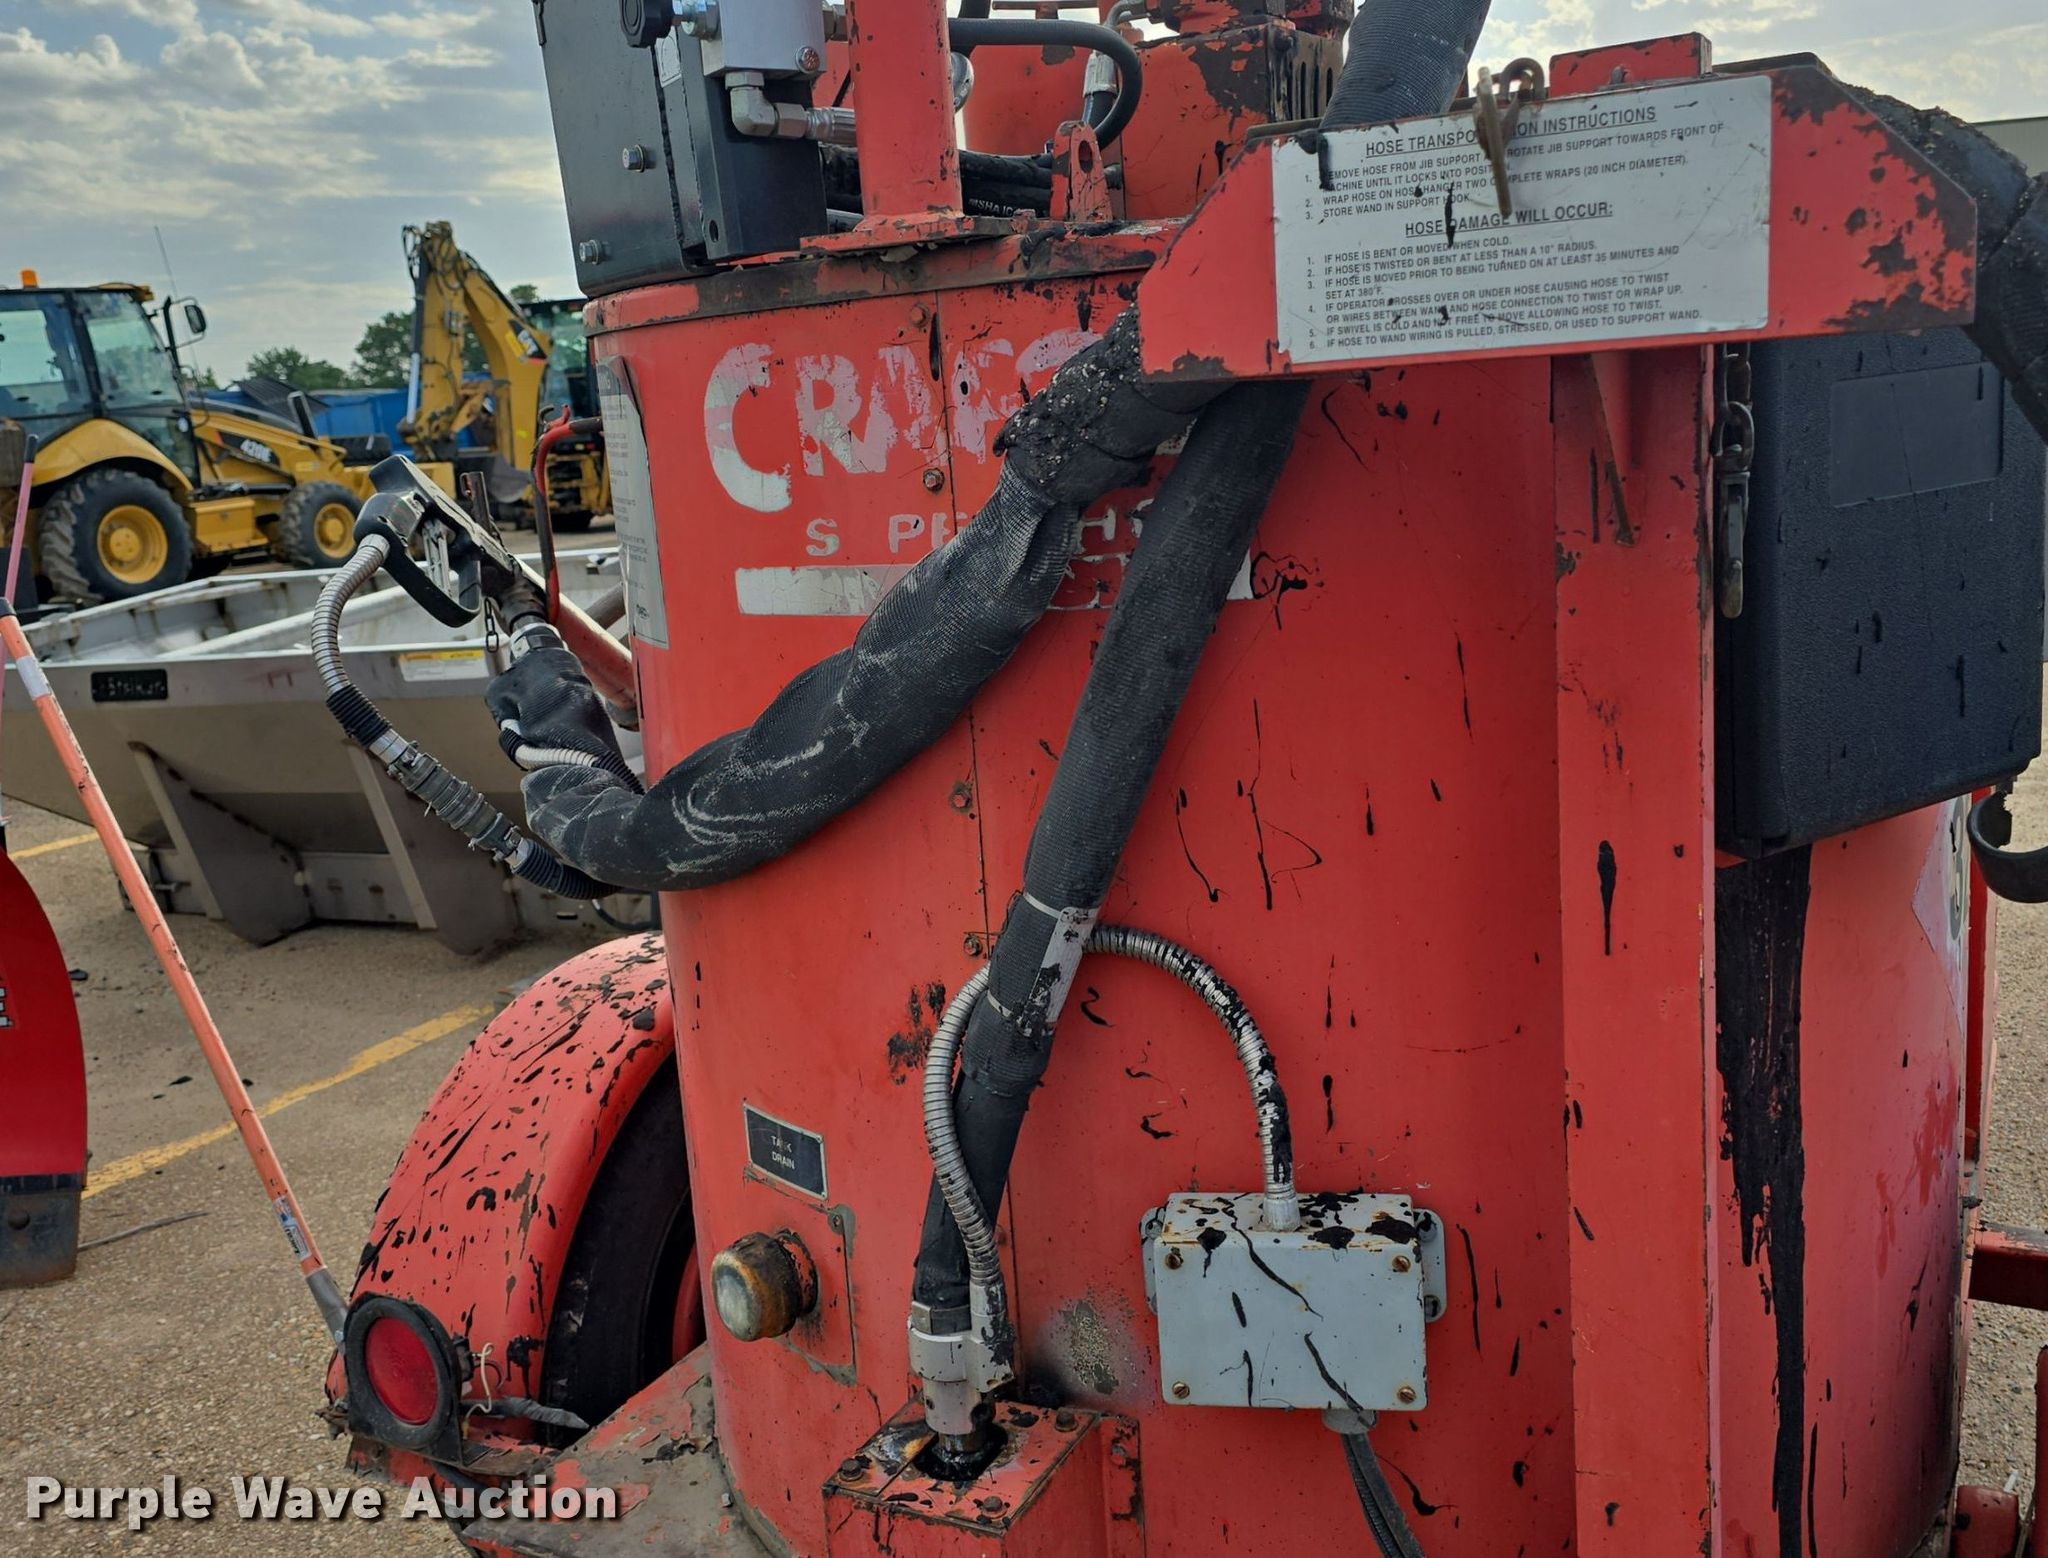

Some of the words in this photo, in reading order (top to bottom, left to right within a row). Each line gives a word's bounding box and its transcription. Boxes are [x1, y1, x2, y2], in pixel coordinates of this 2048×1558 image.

[1366, 138, 1403, 155] HOSE
[1410, 121, 1537, 150] TRANSPOION
[1543, 107, 1656, 134] INSTRUCTIONS
[1323, 168, 1360, 180] EMOVE
[1362, 165, 1387, 176] HOSE
[1390, 161, 1416, 172] FROM
[1419, 159, 1433, 169] JIB
[1436, 153, 1481, 167] SUPPORT
[1506, 145, 1544, 158] ROTATE
[1547, 143, 1562, 154] JIB
[1565, 137, 1612, 151] SUPPORT
[1616, 131, 1667, 145] TOWARDS
[1670, 126, 1706, 139] FRONT
[1709, 124, 1724, 134] OF
[1323, 180, 1363, 193] ACHINE
[1366, 177, 1392, 188] UNTIL
[1394, 175, 1403, 185] IT
[1405, 171, 1437, 183] LOCKS
[1440, 169, 1461, 179] INTO
[1323, 194, 1349, 205] WRAP
[1351, 190, 1376, 202] HOSE
[1379, 189, 1392, 199] ON
[1394, 185, 1421, 197] HOS
[1465, 178, 1486, 189] TWO
[1545, 167, 1580, 180] WRAPS
[1583, 165, 1598, 177] (20
[1601, 162, 1625, 174] INCH
[1323, 206, 1353, 218] STORE
[1355, 203, 1382, 214] WAND
[1385, 202, 1393, 211] IN
[1396, 196, 1440, 210] SUPPORT
[1405, 220, 1443, 235] HOSE
[1515, 208, 1549, 224] WILL
[1324, 254, 1333, 263] IF
[1335, 252, 1359, 262] HOSE
[1361, 250, 1370, 260] IS
[1373, 248, 1397, 258] BENT
[1399, 246, 1413, 256] OR
[1415, 243, 1449, 254] MOVED
[1452, 240, 1480, 251] WHEN
[1324, 266, 1333, 275] IF
[1335, 264, 1359, 274] HOSE
[1362, 262, 1371, 272] IS
[1373, 258, 1414, 271] TWISTED
[1416, 257, 1430, 267] OR
[1432, 254, 1457, 265] BENT
[1459, 253, 1471, 263] AT
[1474, 250, 1498, 261] LESS
[1501, 247, 1527, 259] THAN
[1530, 247, 1536, 256] A
[1540, 245, 1554, 255] 10"
[1325, 278, 1333, 287] IF
[1335, 276, 1360, 286] HOSE
[1362, 275, 1371, 284] IS
[1374, 271, 1406, 283] MOVED
[1408, 269, 1437, 280] PRIOR
[1440, 267, 1453, 277] TO
[1455, 264, 1485, 275] BEING
[1487, 260, 1526, 273] TURNED
[1529, 259, 1543, 269] ON
[1545, 257, 1558, 267] AT
[1560, 254, 1592, 266] LEAST
[1594, 253, 1607, 263] 35
[1609, 248, 1655, 261] MINUTES
[1657, 246, 1680, 257] AND
[1325, 302, 1334, 311] IF
[1336, 298, 1385, 310] OPERATOR
[1434, 292, 1459, 302] OVER
[1462, 290, 1475, 300] OR
[1478, 287, 1511, 298] UNDER
[1514, 285, 1540, 295] HOSE
[1543, 280, 1587, 293] CAUSING
[1590, 278, 1618, 289] HOSE
[1621, 276, 1634, 286] TO
[1638, 273, 1670, 285] TWIST
[1325, 290, 1342, 300] SET
[1344, 289, 1355, 298] AT
[1326, 314, 1340, 323] OR
[1342, 312, 1370, 322] WIRES
[1373, 308, 1417, 320] BETWEEN
[1420, 305, 1447, 316] WAN
[1449, 303, 1469, 313] AND
[1471, 301, 1497, 311] HOSE
[1500, 295, 1563, 309] CONNECTION
[1567, 294, 1580, 304] TO
[1583, 291, 1613, 302] TWIST
[1615, 290, 1631, 300] OR
[1633, 287, 1664, 298] WRAP
[1326, 327, 1335, 335] IF
[1337, 324, 1370, 335] SWIVEL
[1373, 323, 1382, 332] IS
[1384, 321, 1409, 331] COLD
[1411, 319, 1431, 329] AND
[1455, 315, 1479, 325] FREE
[1483, 314, 1494, 323] TO
[1527, 307, 1579, 320] ALLOWING
[1582, 305, 1608, 315] HOSE
[1612, 303, 1626, 313] TO
[1326, 339, 1335, 347] IF
[1337, 336, 1362, 347] HOSE
[1365, 335, 1376, 344] TO
[1379, 333, 1406, 343] WAND
[1409, 330, 1442, 341] WIRING
[1444, 329, 1454, 338] IS
[1554, 320, 1568, 330] OR
[1571, 318, 1598, 329] USED
[1601, 317, 1614, 327] TO
[1617, 313, 1664, 325] SUPPORT
[770, 1135, 793, 1153] TAK
[771, 1151, 796, 1170] DRAIN
